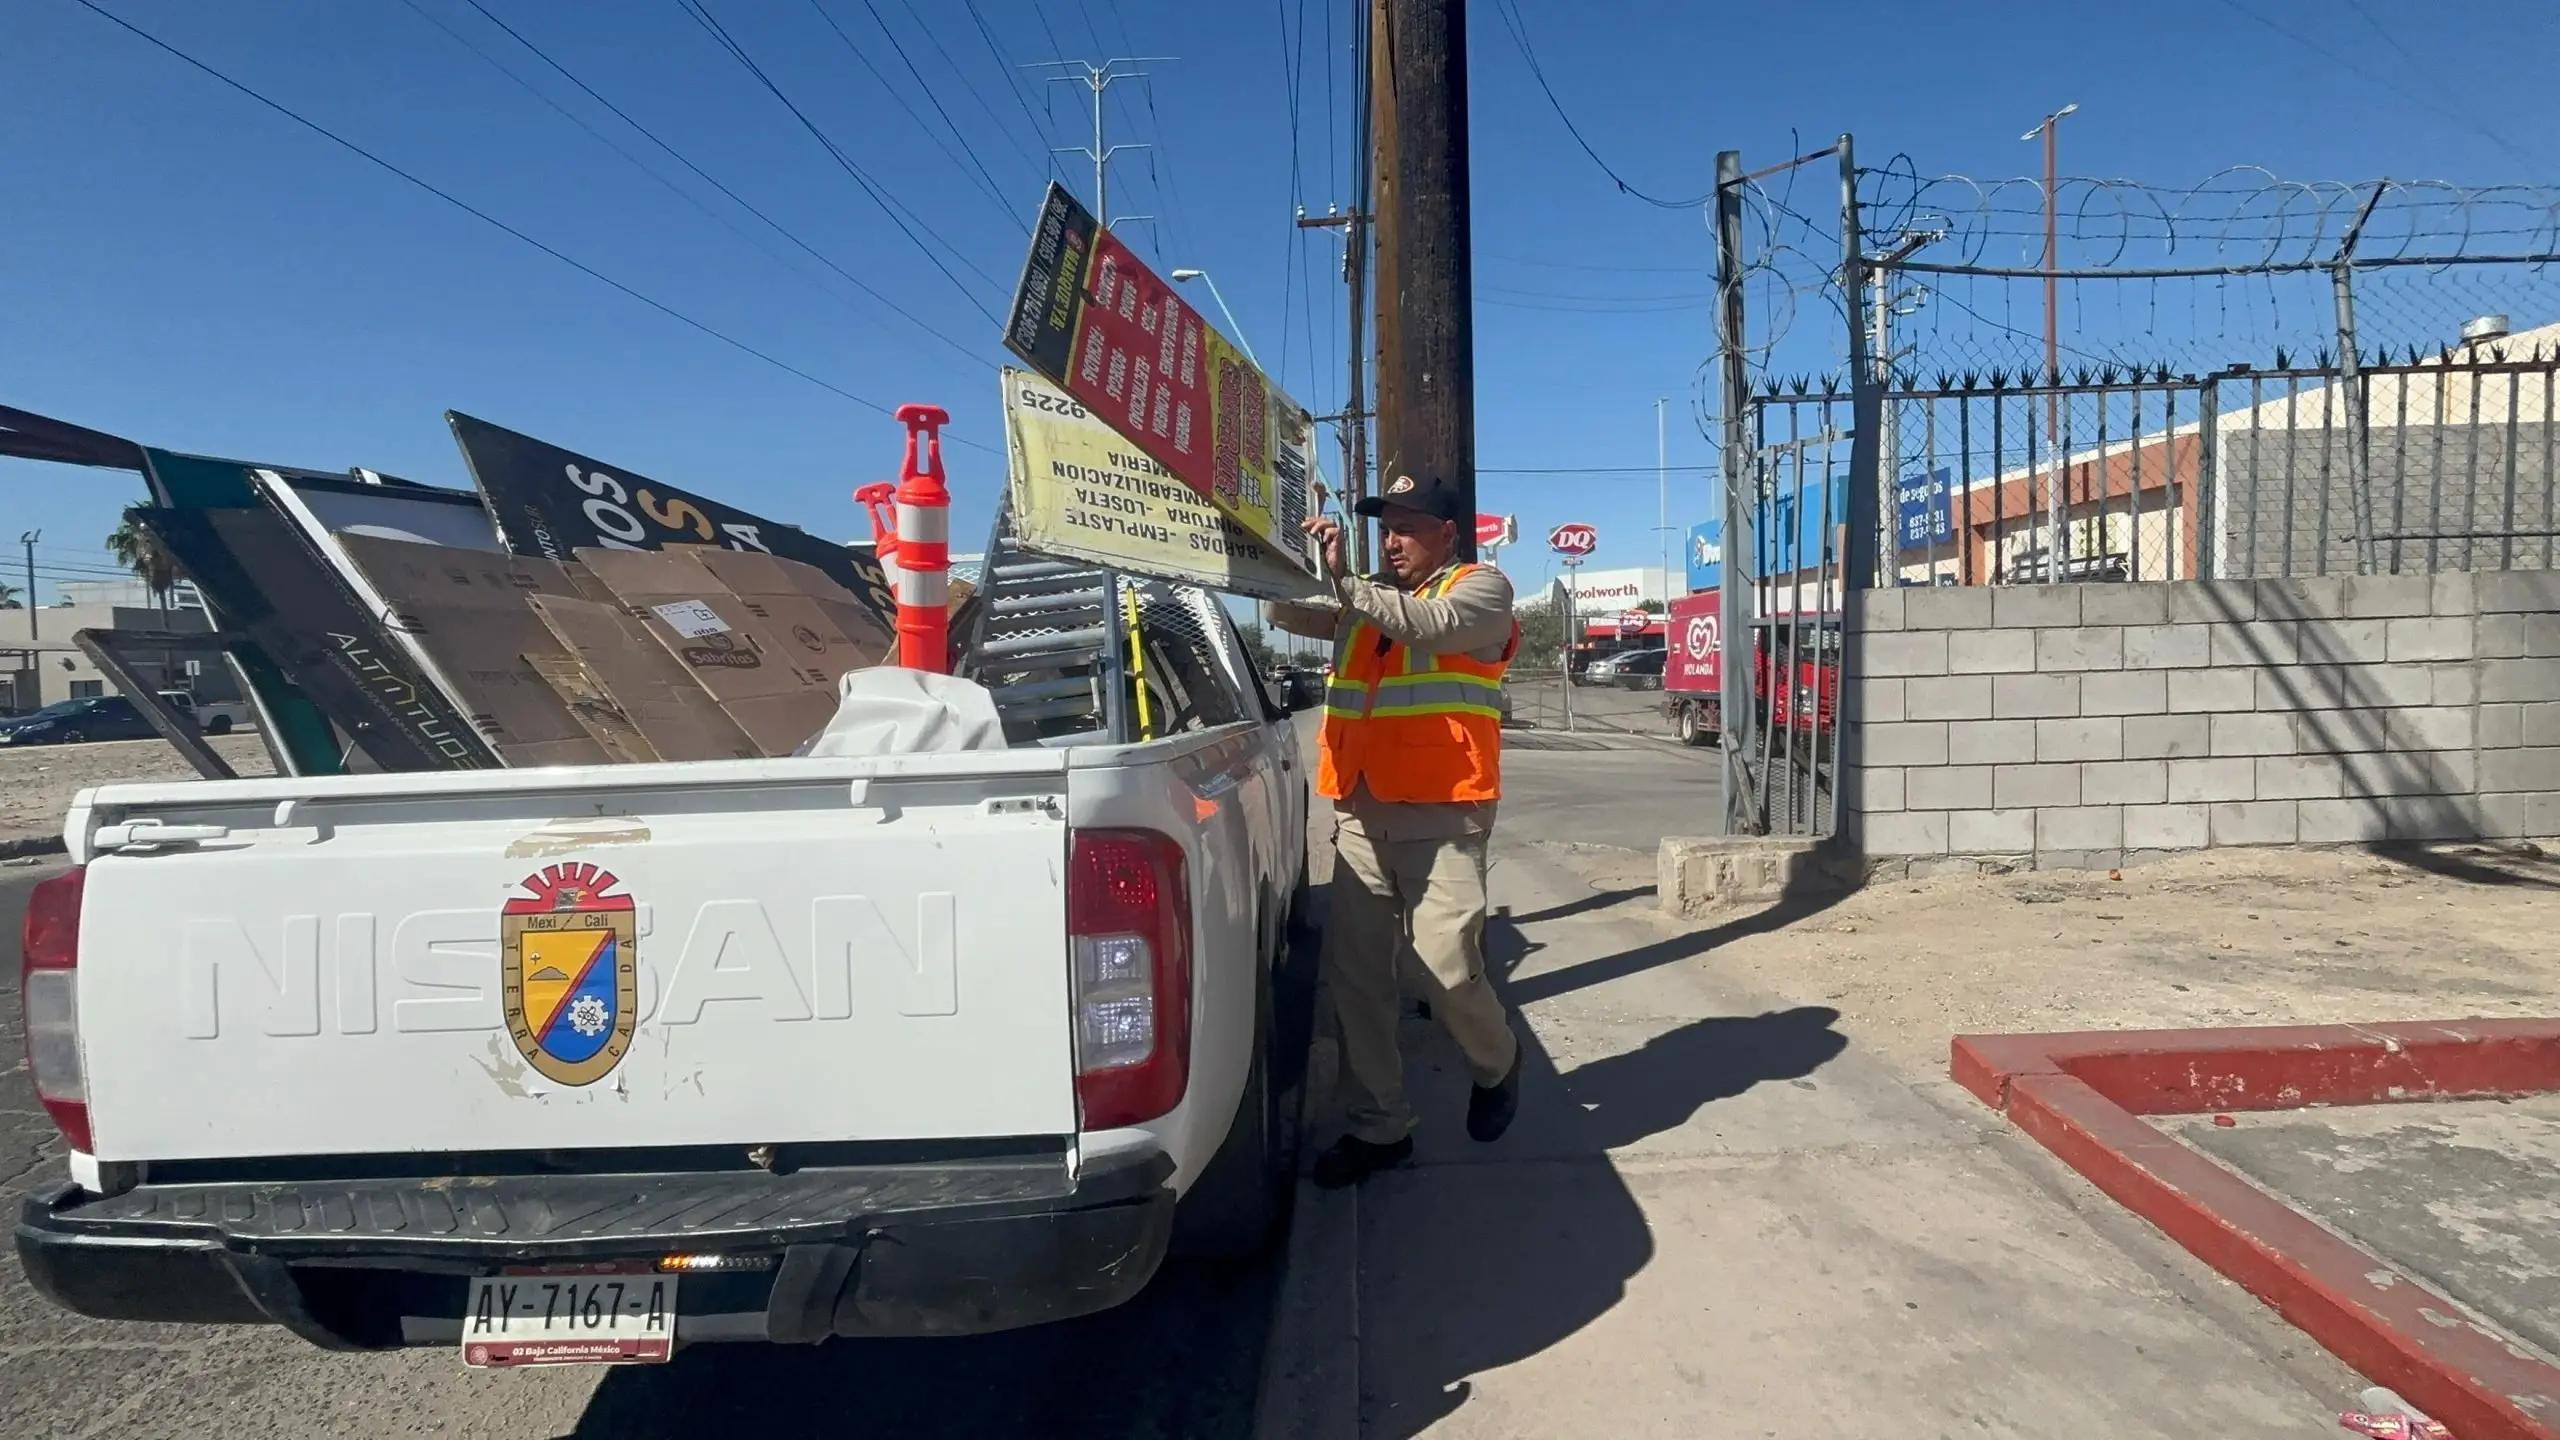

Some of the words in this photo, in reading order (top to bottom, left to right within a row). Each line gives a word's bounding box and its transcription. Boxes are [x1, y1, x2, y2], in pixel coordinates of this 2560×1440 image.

[1056, 245, 1079, 307] MARQUE
[1120, 282, 1136, 322] BARDAS
[1081, 327, 1104, 386] FACHADAS
[1160, 299, 1179, 379] REMODELACIONES
[1181, 321, 1198, 389] AMPLIACIONES
[1106, 349, 1127, 402] BODEGAS
[1128, 357, 1150, 431] ELECTRICIDAD
[1021, 389, 1086, 420] 9225
[1152, 384, 1170, 438] PLOMERÍA
[1076, 487, 1154, 514] -LOSETA
[1911, 480, 1943, 503] seguos
[1557, 530, 1591, 549] DQ
[689, 650, 755, 666] Sabritas
[1683, 664, 1714, 676] HOLANDA
[527, 915, 557, 929] Mexi
[584, 913, 609, 928] Cali
[185, 891, 960, 1040] NISAN
[506, 942, 540, 1061] TIERRA
[607, 939, 633, 1058] CALIDA
[473, 1281, 664, 1333] AY-7167-A
[512, 1347, 525, 1356] 02
[525, 1347, 545, 1358] Baja
[546, 1345, 589, 1355] California
[590, 1344, 620, 1355] México
